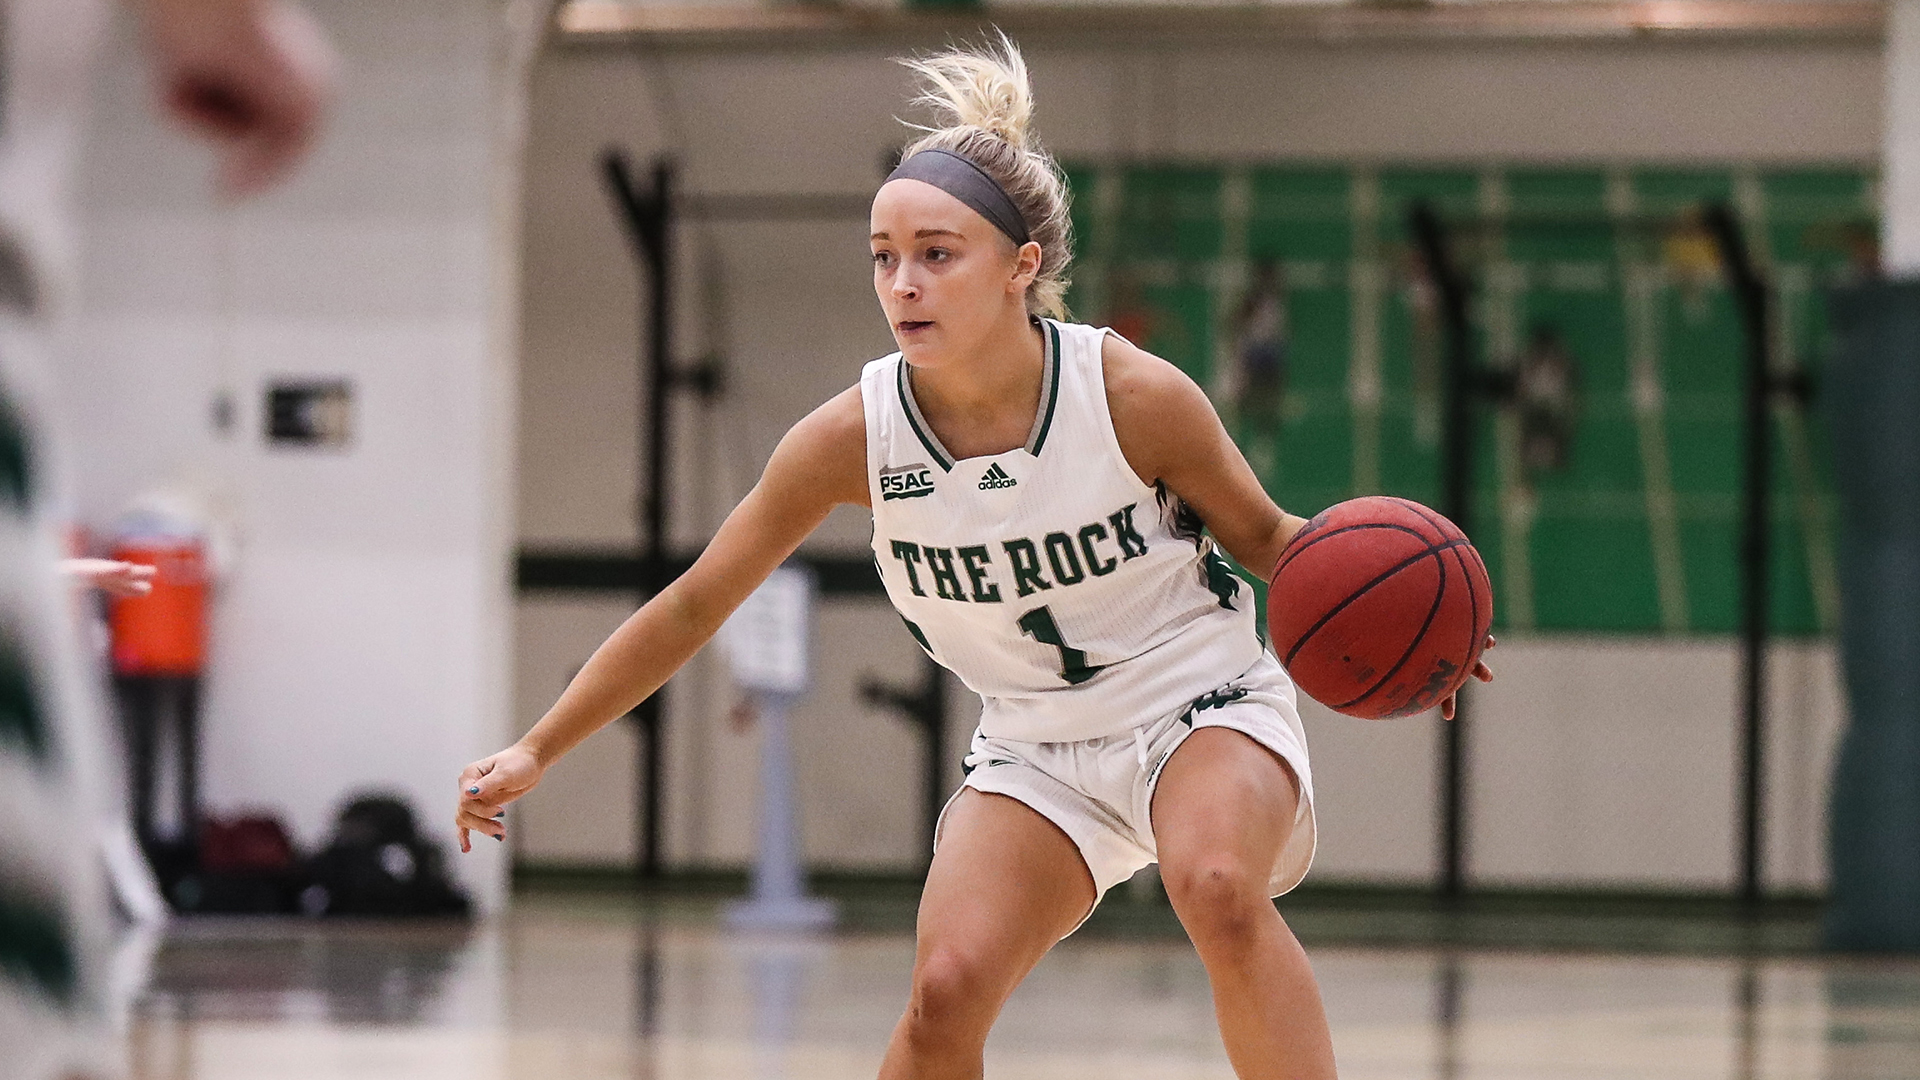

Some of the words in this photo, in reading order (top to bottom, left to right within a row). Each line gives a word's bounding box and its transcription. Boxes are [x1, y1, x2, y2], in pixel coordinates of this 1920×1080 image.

[880, 470, 934, 492] PSAC
[978, 478, 1017, 490] adidas
[889, 538, 1004, 603] THE
[1001, 502, 1149, 598] ROCK
[1016, 604, 1107, 685] 1
